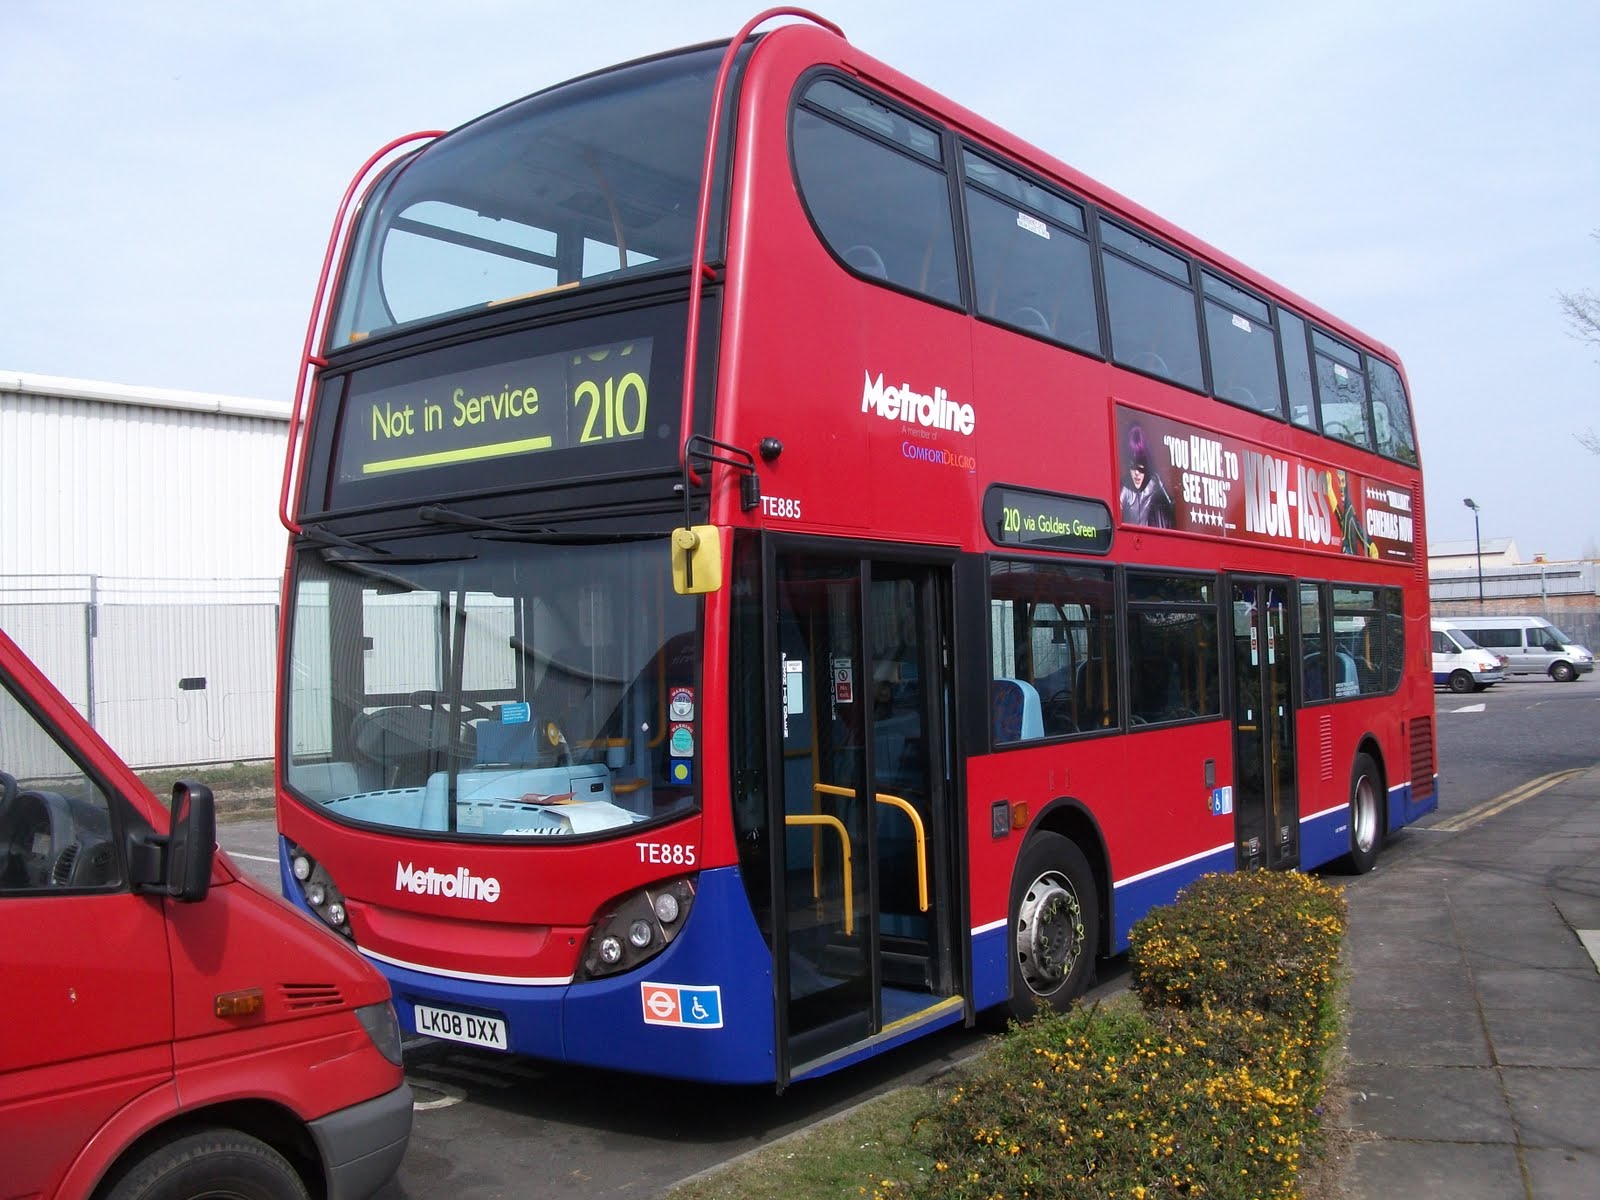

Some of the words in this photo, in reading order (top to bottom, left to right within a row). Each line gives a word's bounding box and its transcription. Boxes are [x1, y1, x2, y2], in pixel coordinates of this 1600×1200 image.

[372, 402, 415, 441] Not
[424, 398, 443, 433] in
[452, 383, 539, 427] Service
[574, 372, 647, 443] 210
[861, 368, 976, 436] Metroline
[1190, 434, 1224, 478] HAVE
[1224, 451, 1239, 481] TO
[760, 495, 801, 519] TE885
[1182, 472, 1202, 504] SEE
[1003, 507, 1021, 532] 210
[1023, 515, 1036, 531] via
[1038, 514, 1071, 535] Golders
[1072, 519, 1097, 538] Green
[635, 842, 696, 866] TE885
[395, 860, 501, 903] Metroline
[420, 1008, 463, 1037] LK08
[466, 1017, 499, 1043] DXX
